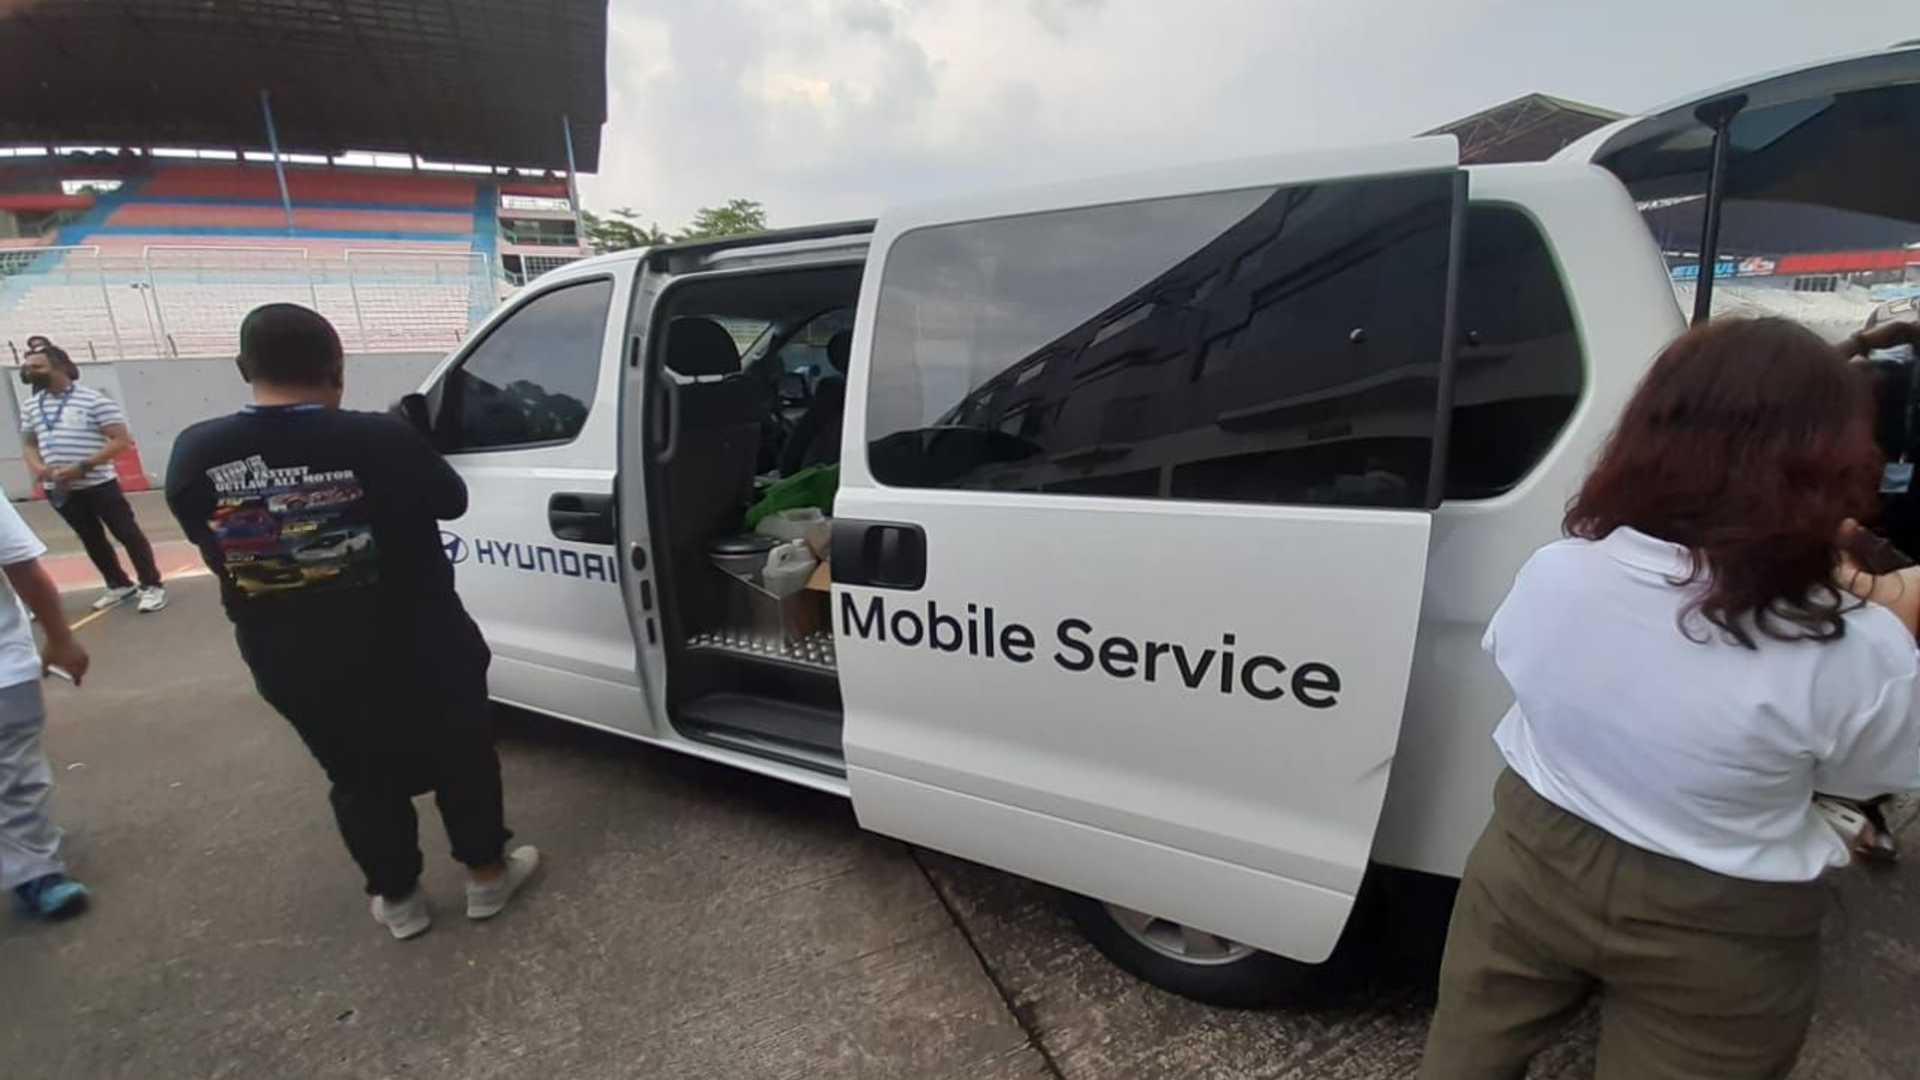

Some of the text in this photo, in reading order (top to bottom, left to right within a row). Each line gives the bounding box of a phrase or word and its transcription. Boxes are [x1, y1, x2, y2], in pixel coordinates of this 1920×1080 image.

[274, 476, 299, 487] ALL
[303, 469, 354, 484] MOTOR
[475, 538, 617, 583] HYUNDAI
[840, 592, 1342, 709] Mobile Service
